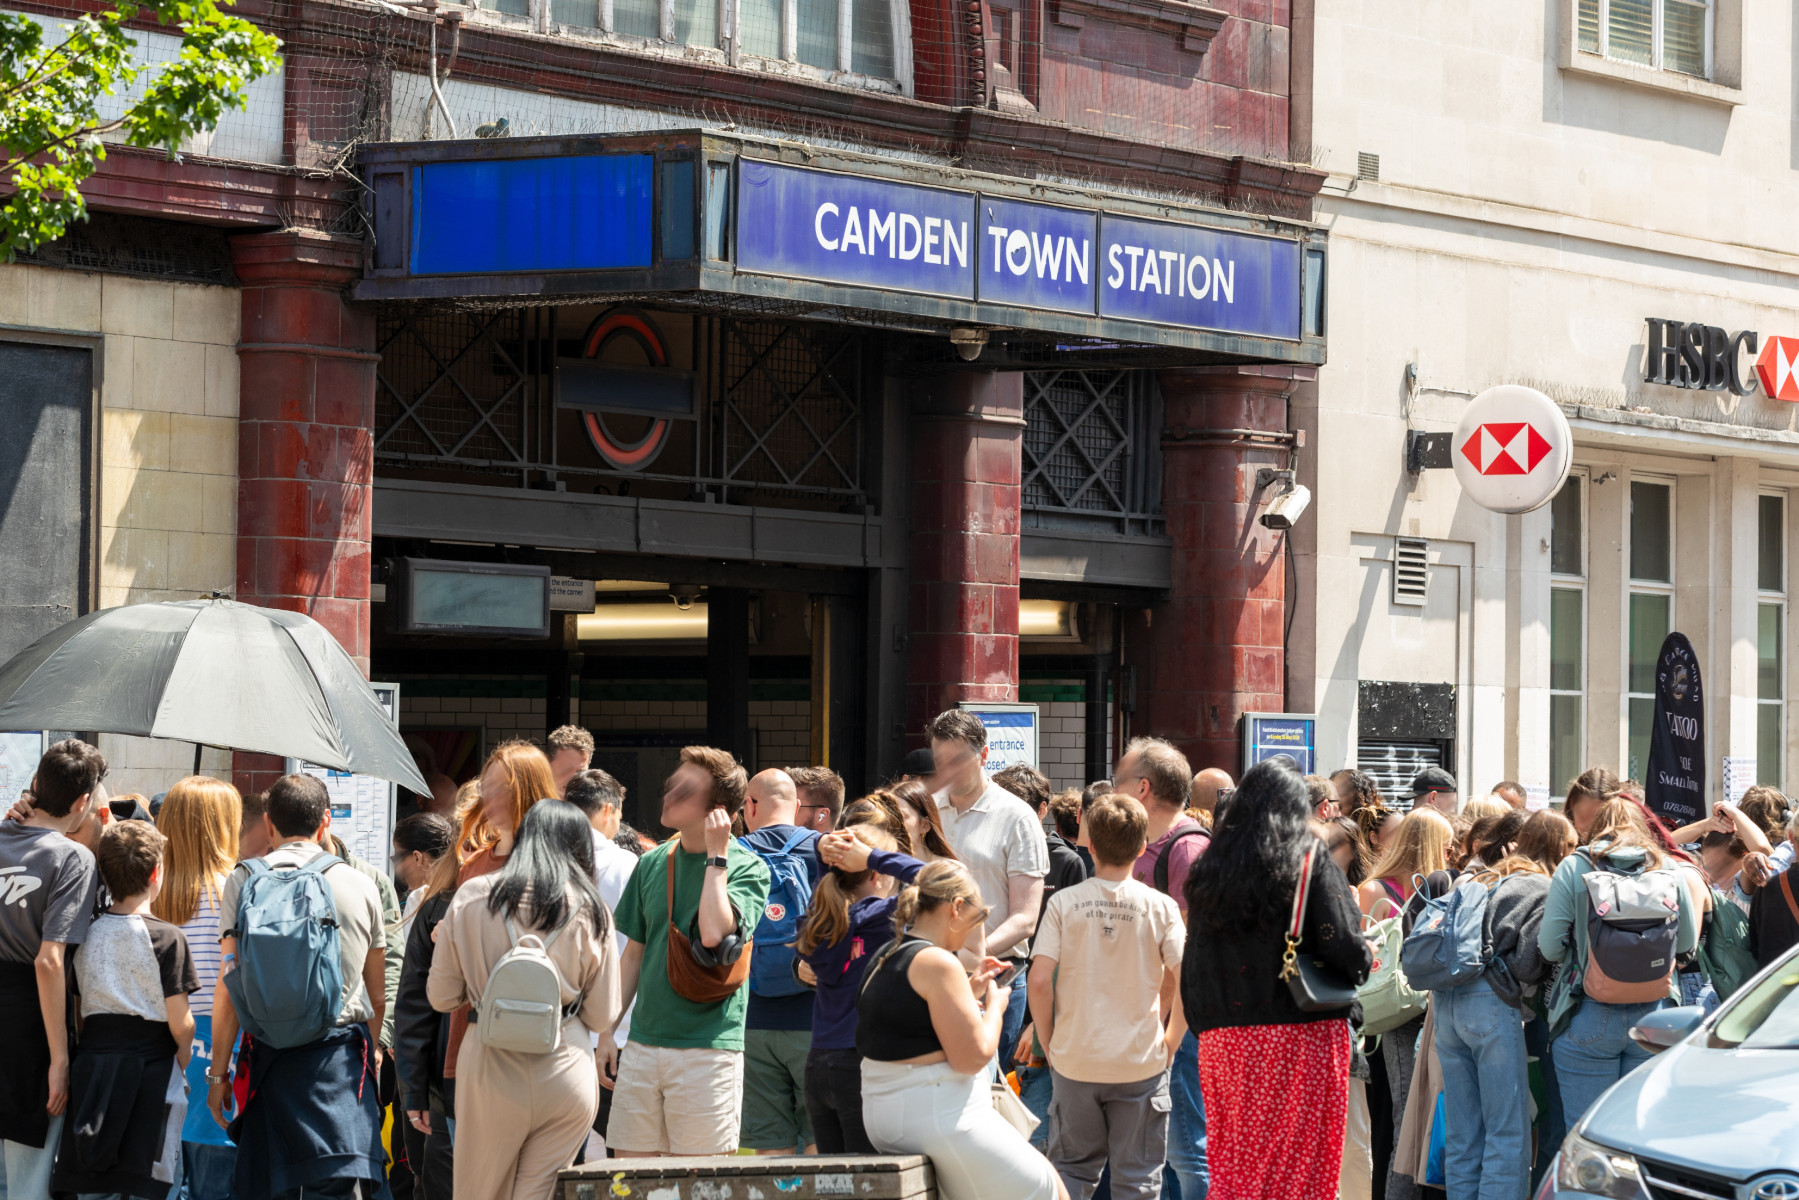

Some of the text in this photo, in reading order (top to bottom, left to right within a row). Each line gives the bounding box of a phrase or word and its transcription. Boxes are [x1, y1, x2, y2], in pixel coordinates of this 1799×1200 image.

[815, 202, 1235, 303] CAMDEN TOWN STATION
[1645, 317, 1758, 397] HSBC
[552, 578, 584, 587] the entrance
[989, 739, 1025, 751] entrance
[983, 759, 1006, 771] losed
[1081, 900, 1093, 908] am
[1094, 900, 1118, 908] gonna
[1119, 901, 1128, 909] be
[1086, 909, 1134, 922] of the pirate
